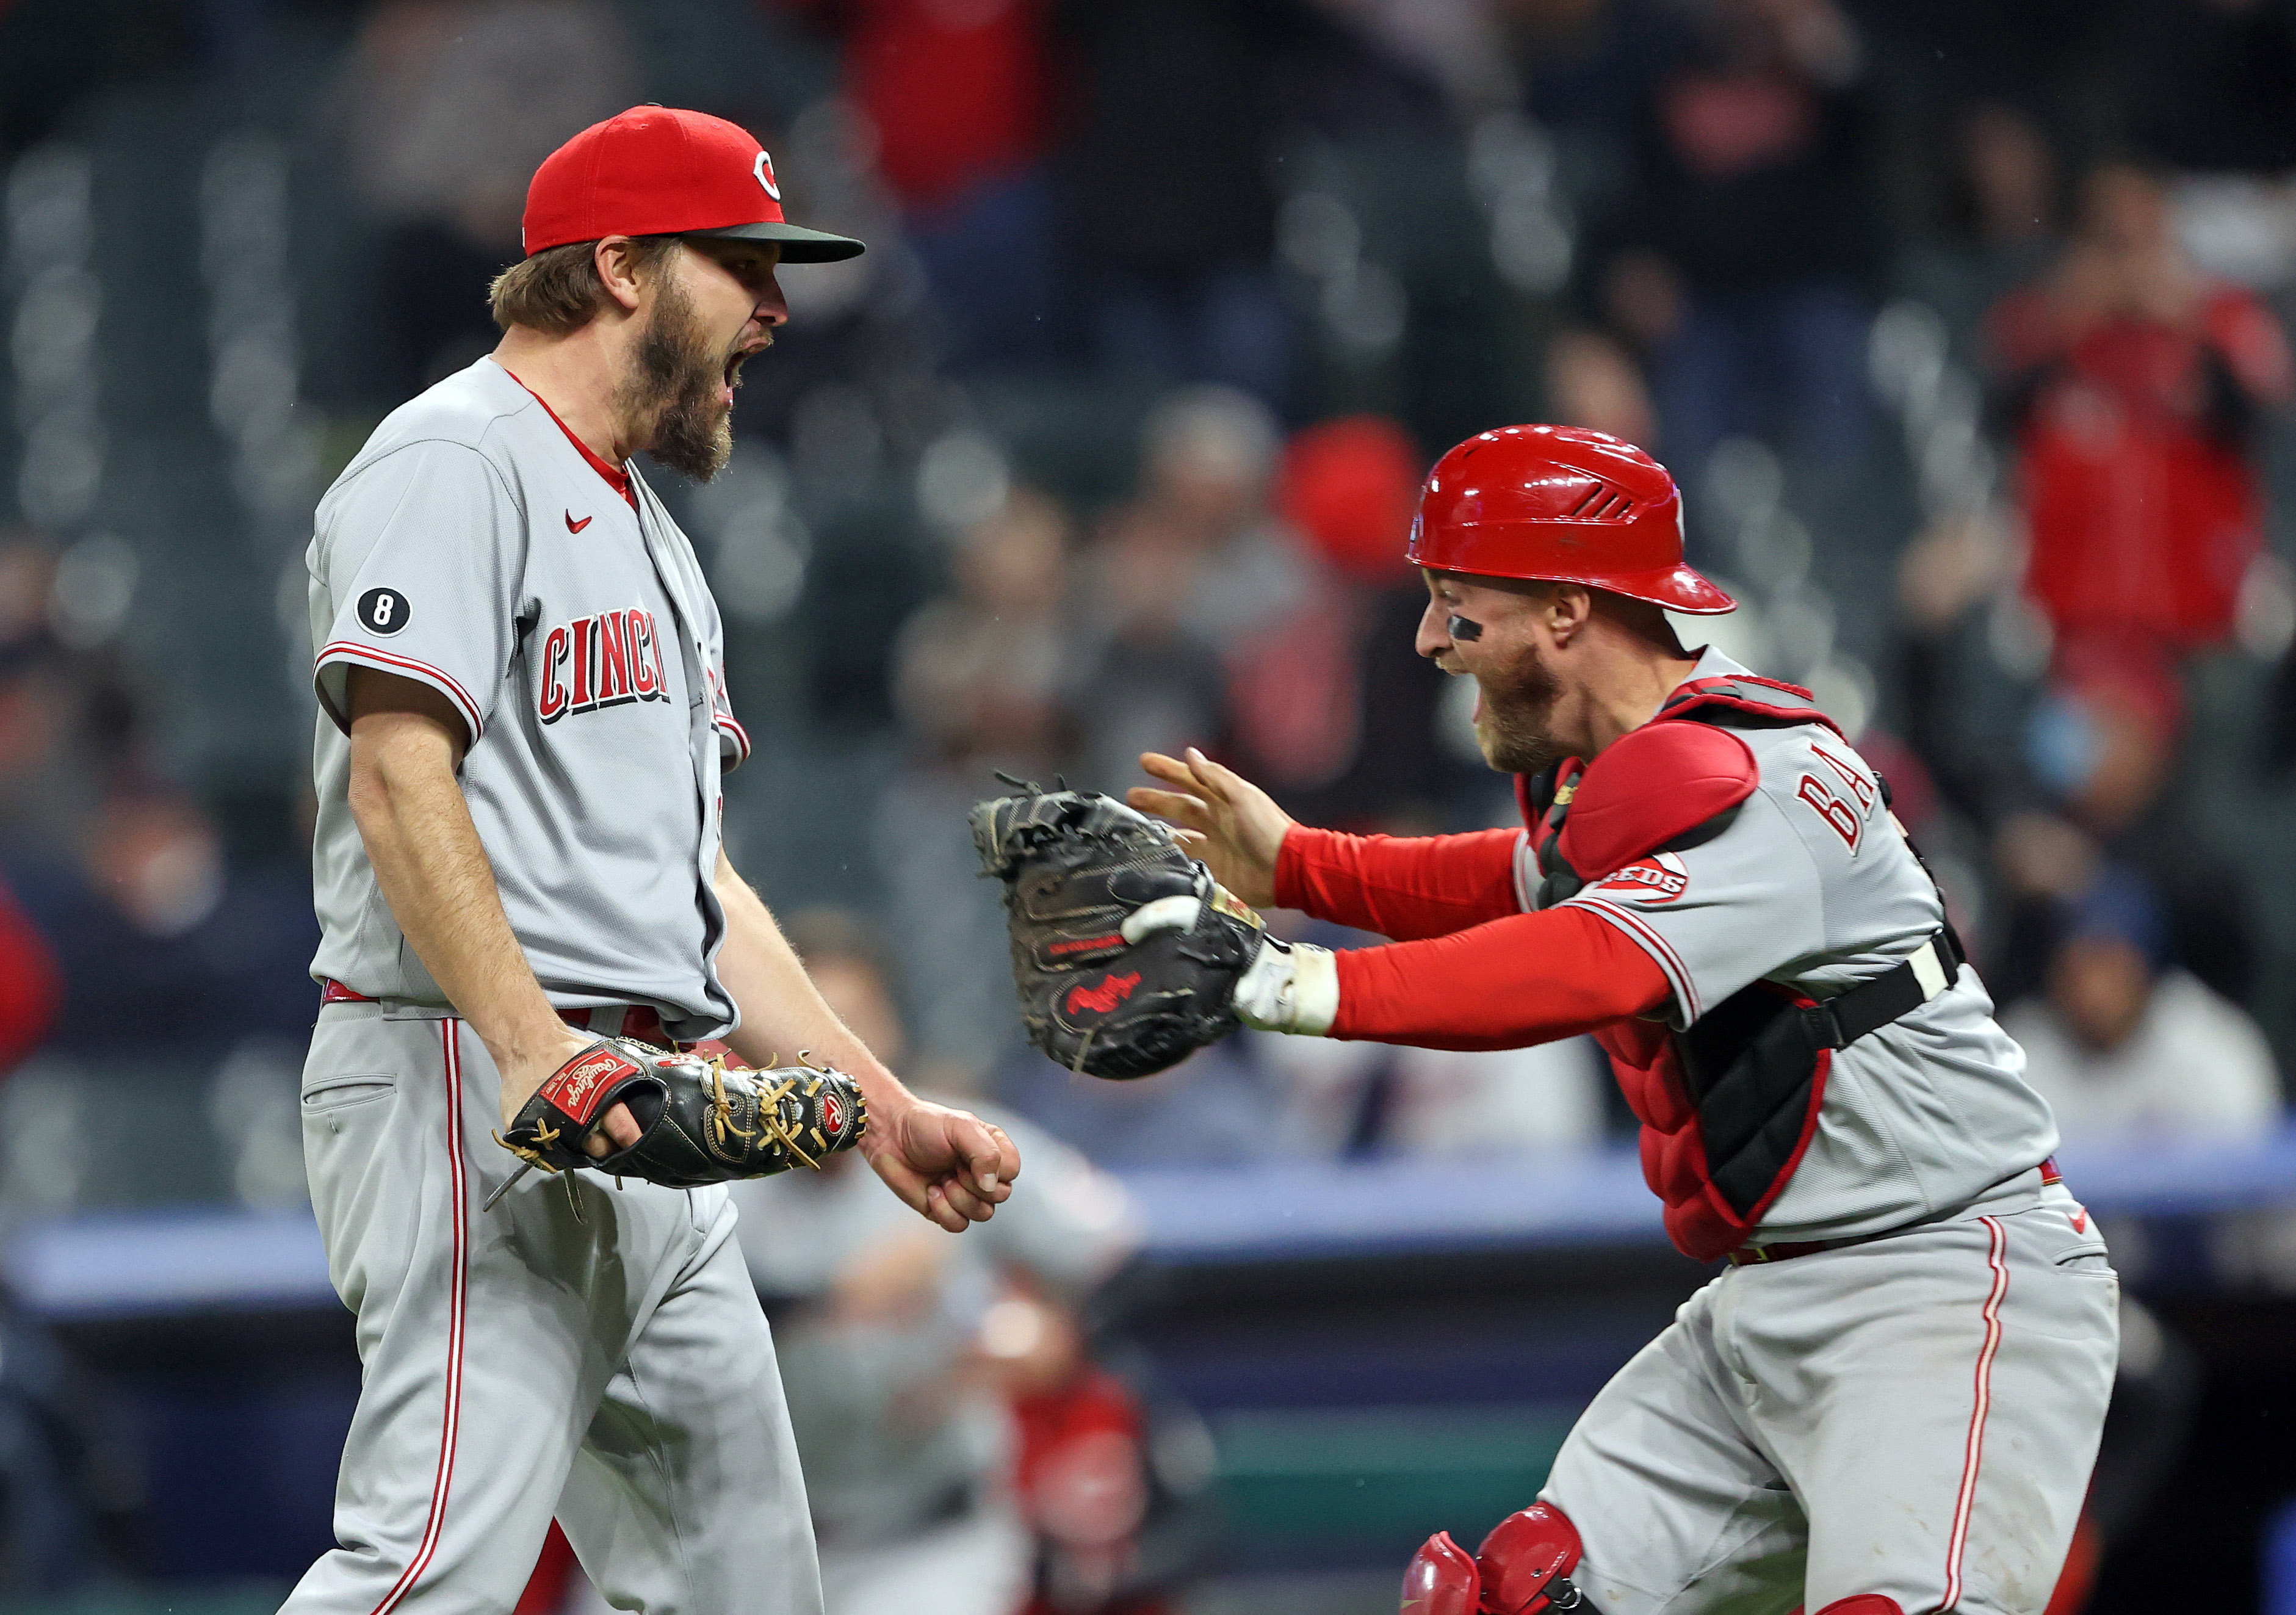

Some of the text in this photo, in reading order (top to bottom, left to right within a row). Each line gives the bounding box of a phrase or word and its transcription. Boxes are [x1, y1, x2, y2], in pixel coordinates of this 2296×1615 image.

[752, 151, 781, 201] C
[374, 594, 394, 626] 8
[1793, 738, 1879, 858] BA
[566, 1058, 617, 1108] Rawlings
[827, 1096, 842, 1125] R
